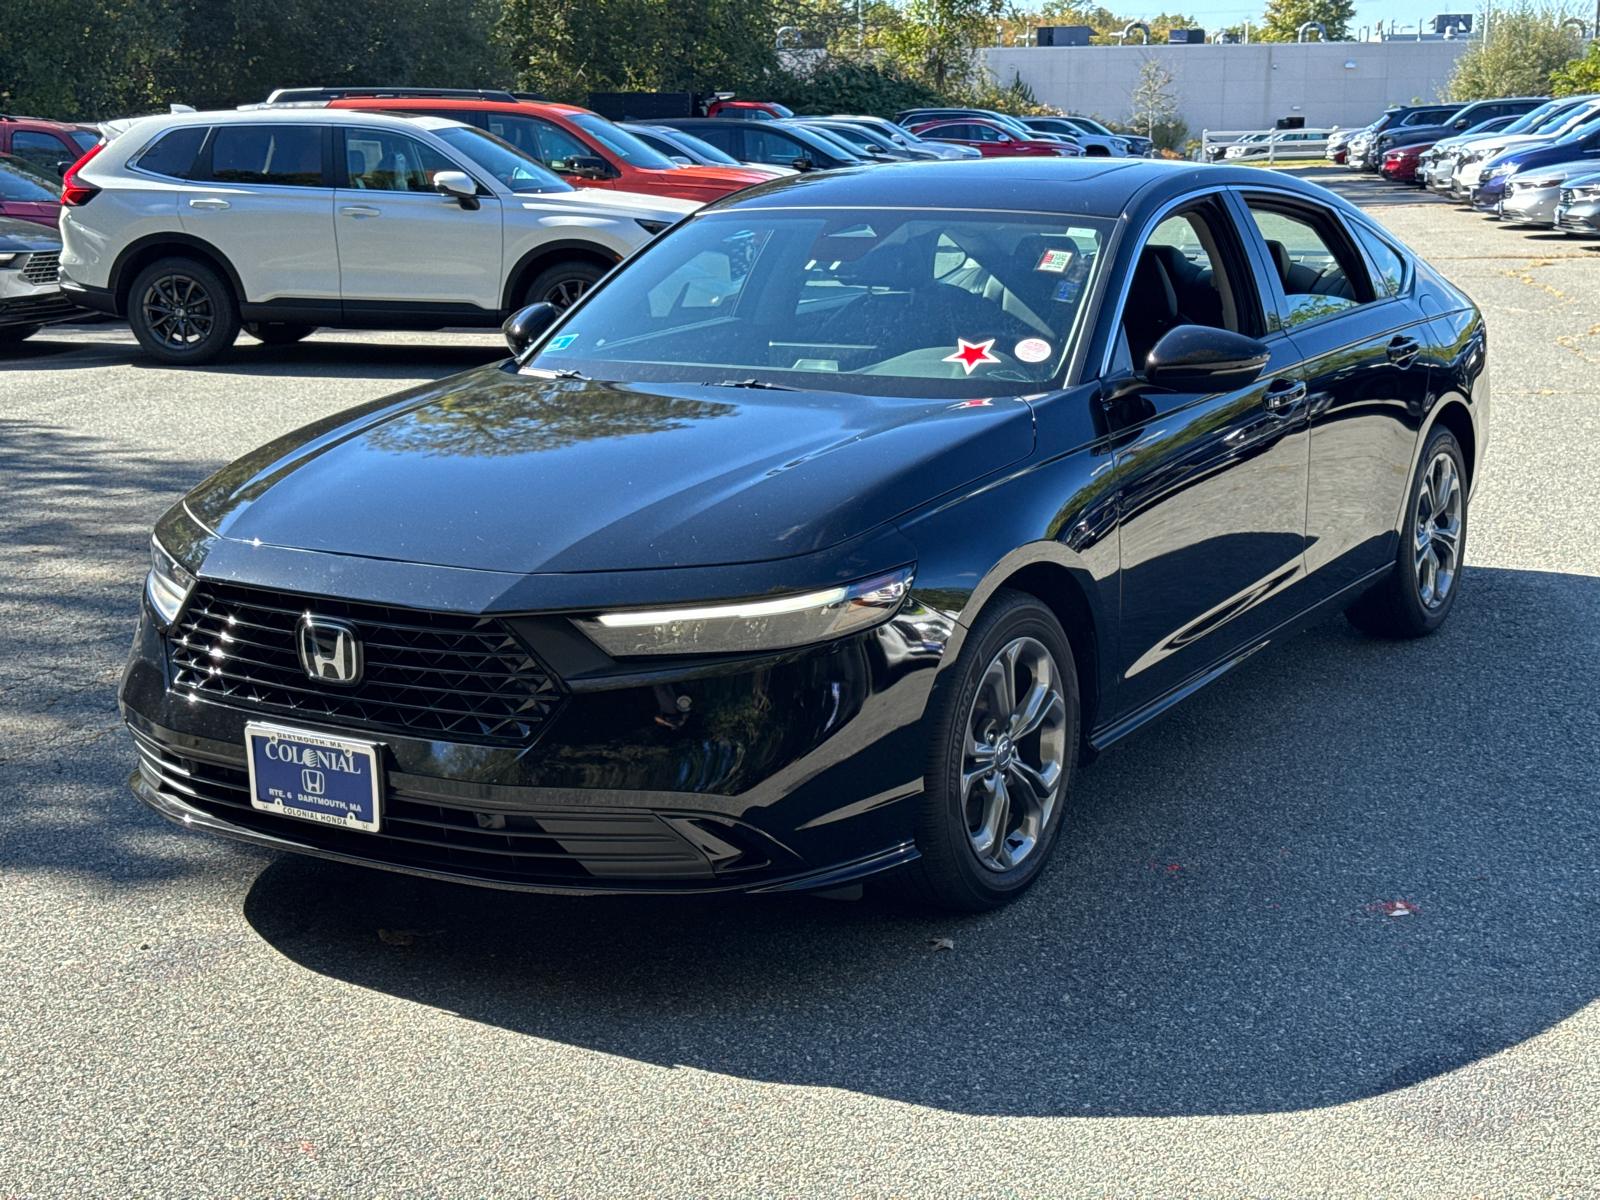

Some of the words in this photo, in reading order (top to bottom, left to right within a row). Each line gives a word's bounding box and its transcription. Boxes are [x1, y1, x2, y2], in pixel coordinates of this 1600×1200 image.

[329, 741, 343, 749] MA
[265, 741, 361, 774] COLONIAL
[268, 788, 286, 798] RTE.
[286, 791, 293, 799] 6
[297, 793, 348, 811] DARTMOUTH,
[349, 803, 362, 813] MA
[282, 806, 319, 820] COLONIAL
[320, 815, 348, 825] HONDA
